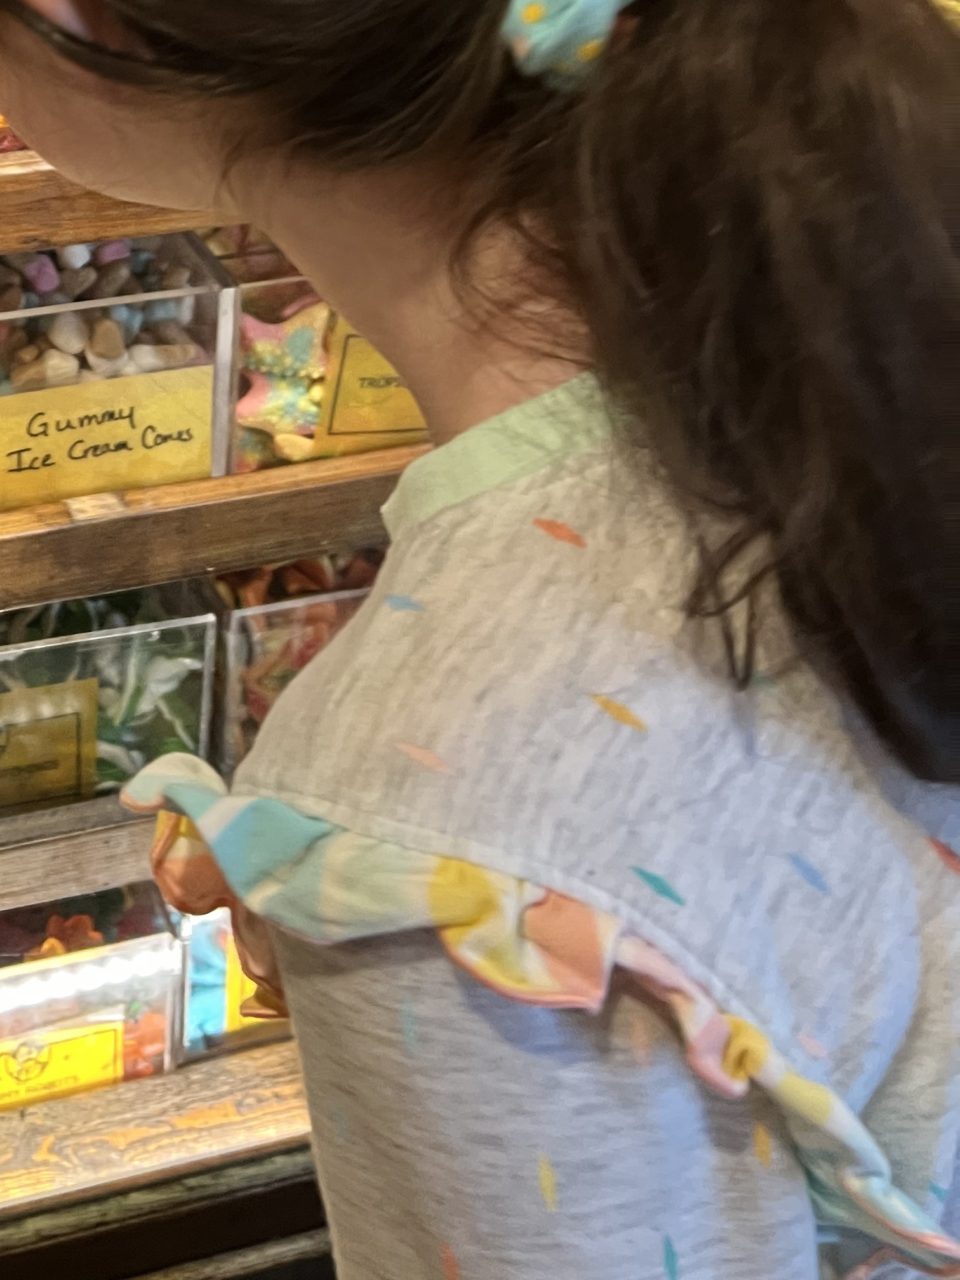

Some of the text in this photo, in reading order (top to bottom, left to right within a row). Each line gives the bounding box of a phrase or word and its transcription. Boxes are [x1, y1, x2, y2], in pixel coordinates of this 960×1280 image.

[25, 405, 137, 439] Gummy
[5, 424, 194, 473] Ice Cream Cones
